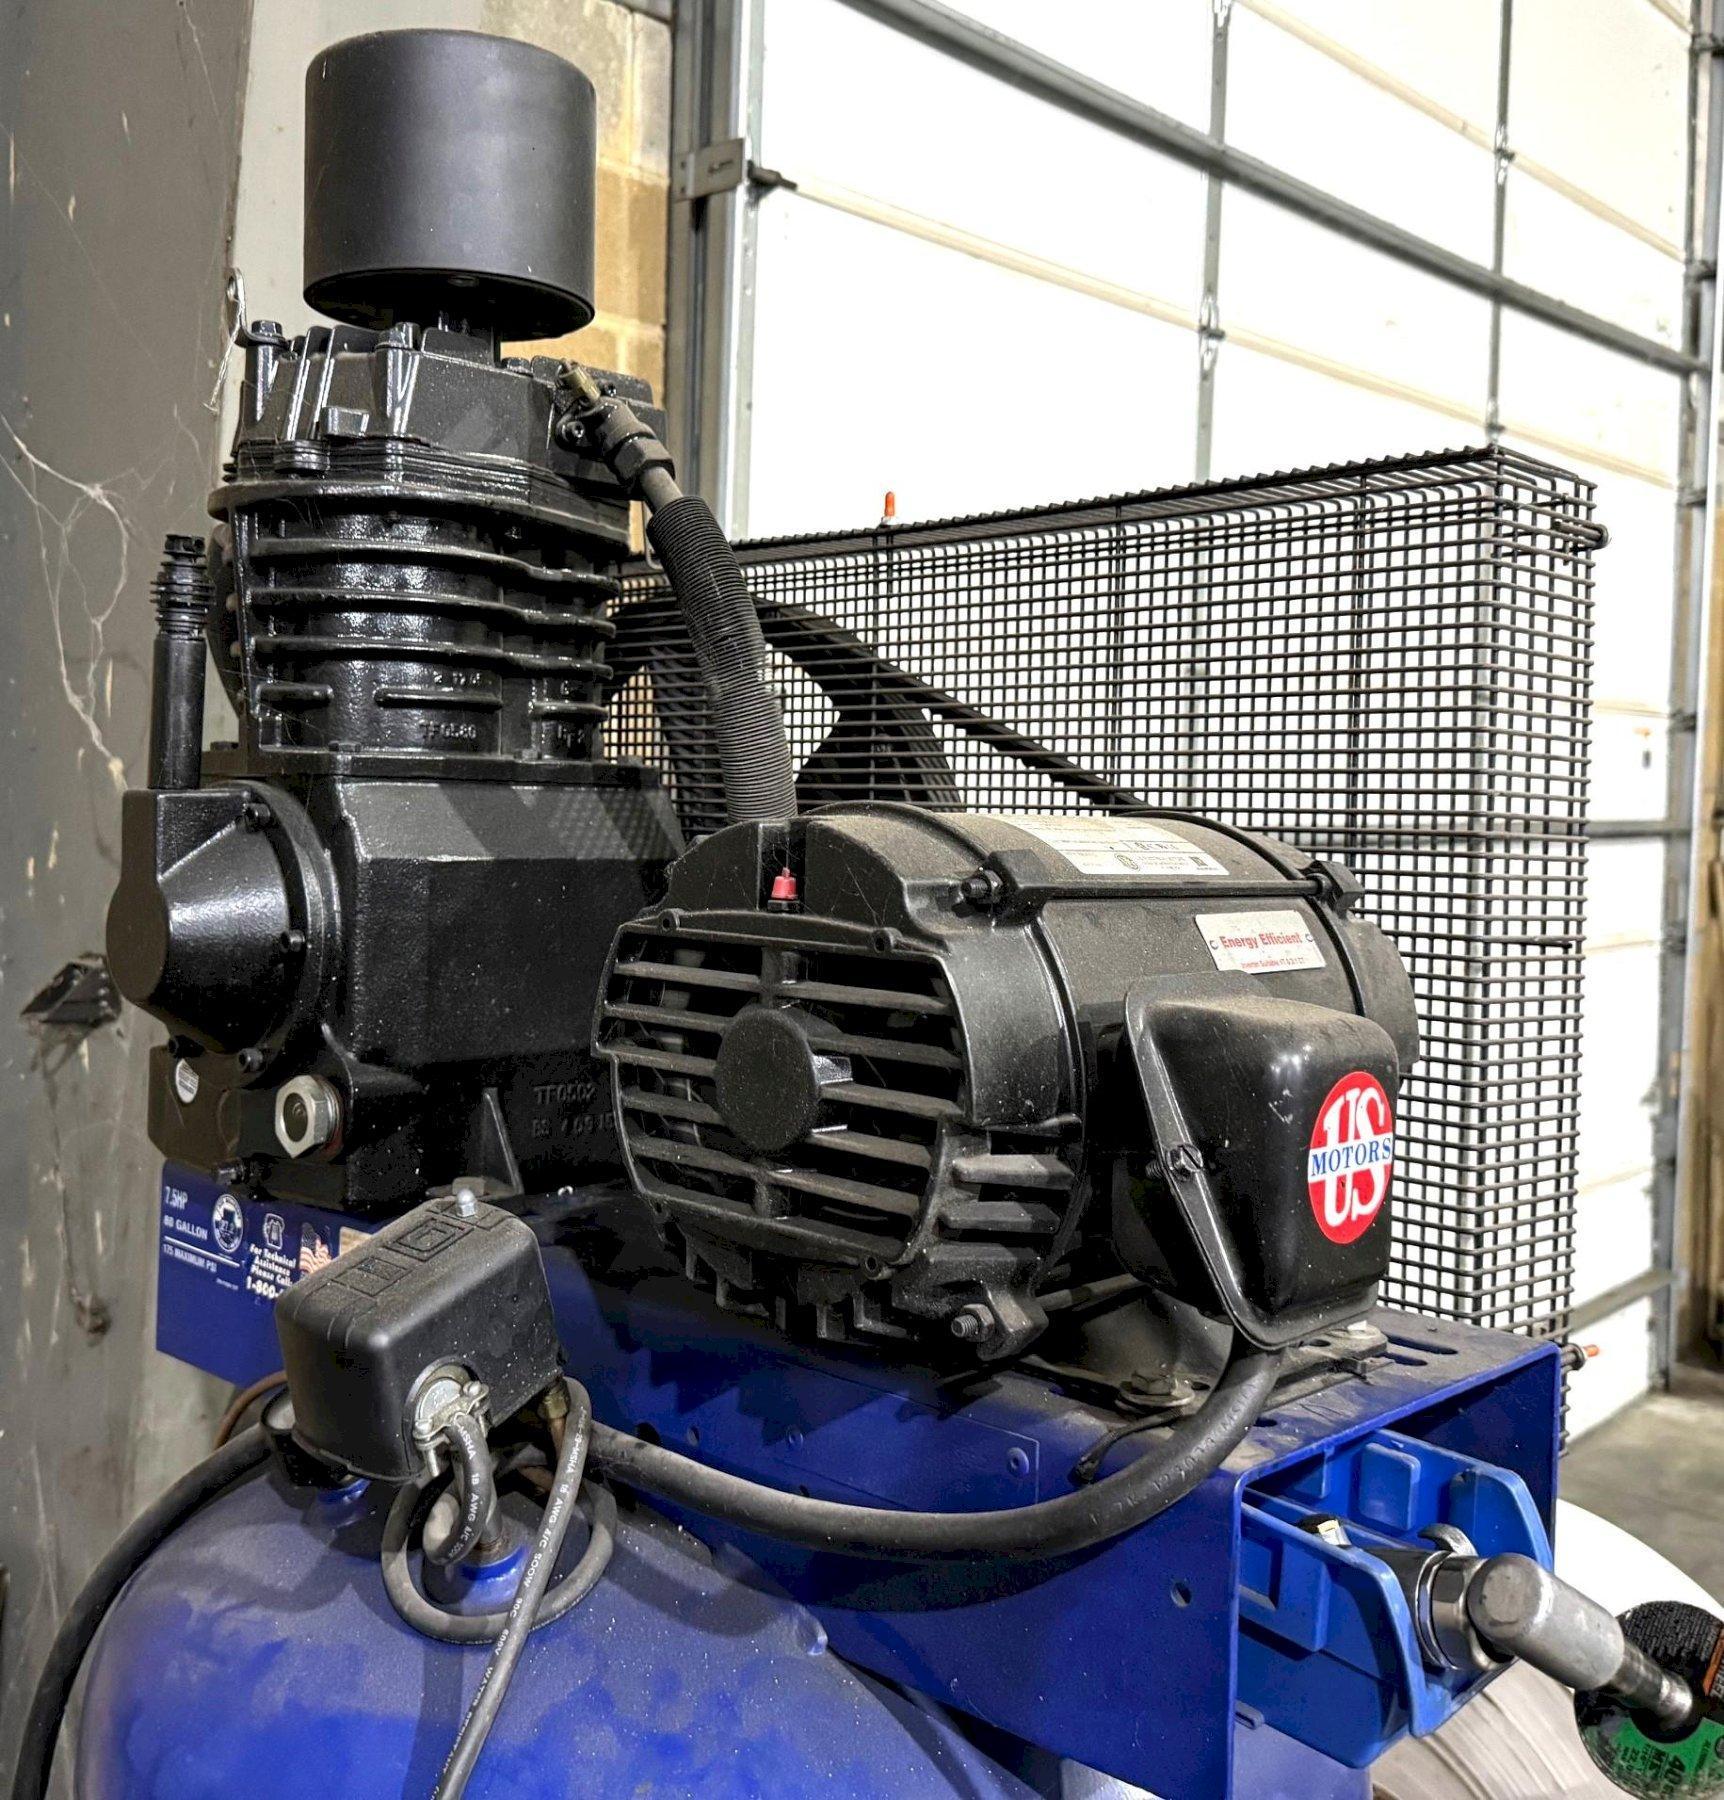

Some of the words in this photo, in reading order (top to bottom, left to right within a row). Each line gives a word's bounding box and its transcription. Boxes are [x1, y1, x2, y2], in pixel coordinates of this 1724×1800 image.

[1219, 936, 1259, 949] Energy
[1259, 931, 1303, 945] Efficient
[1311, 1137, 1392, 1177] MOTORS
[1323, 1087, 1385, 1227] US
[165, 1186, 188, 1210] 7.5HP
[175, 1218, 208, 1240] GALLON
[174, 1247, 205, 1269] MAXIMUM
[254, 1255, 291, 1276] Assistance
[264, 1248, 296, 1268] Technical
[468, 1492, 479, 1522] AWG
[549, 1497, 563, 1524] AWG
[523, 1552, 542, 1588] SOOW
